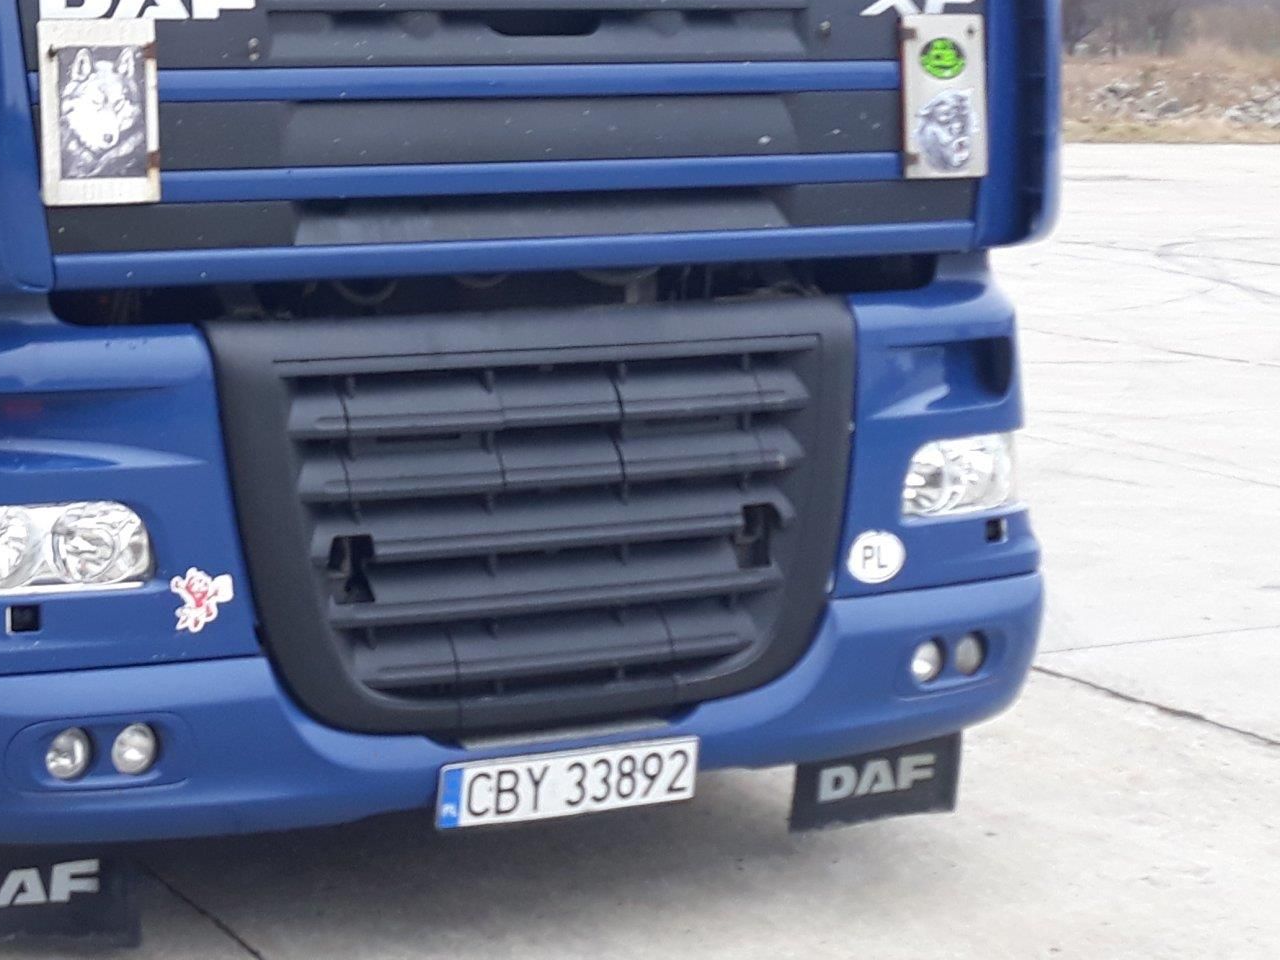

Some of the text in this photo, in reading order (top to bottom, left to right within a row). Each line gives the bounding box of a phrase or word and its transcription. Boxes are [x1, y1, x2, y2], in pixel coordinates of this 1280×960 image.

[862, 545, 888, 570] PL
[467, 749, 689, 817] CBY 33892
[817, 752, 937, 804] DAF
